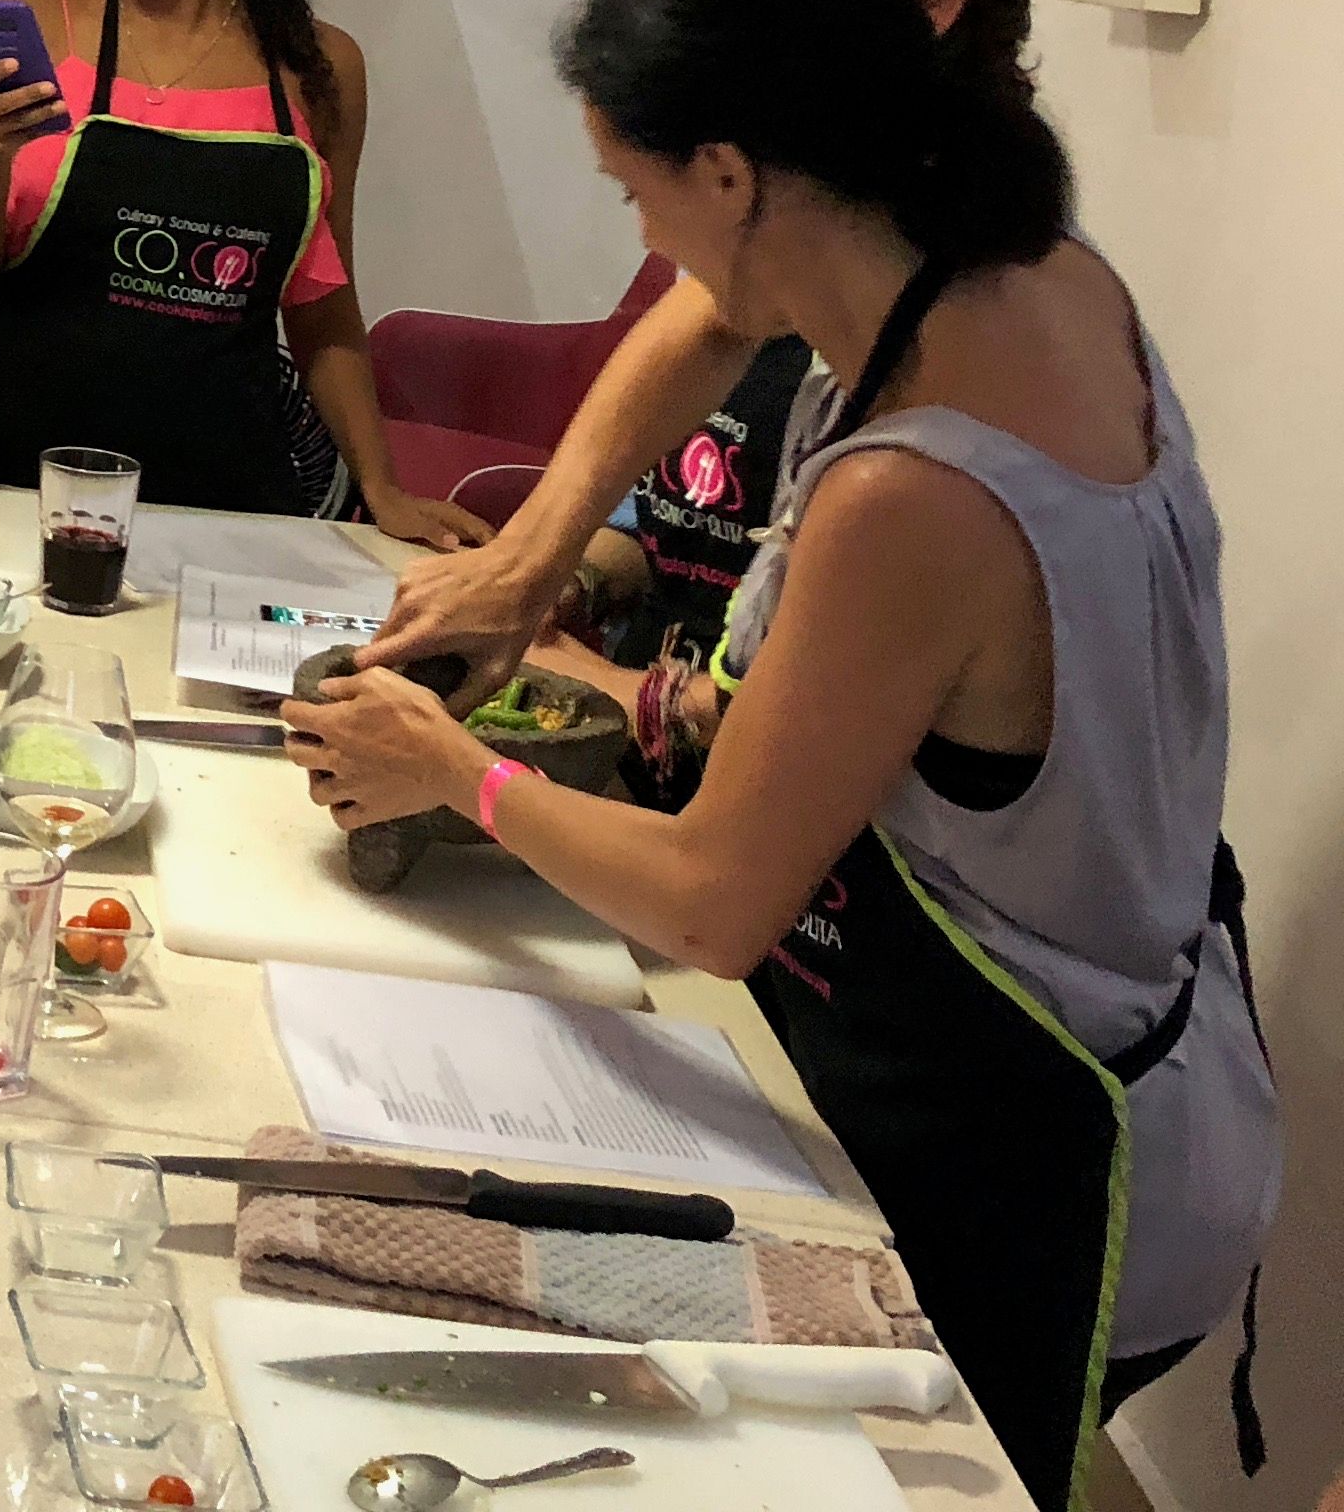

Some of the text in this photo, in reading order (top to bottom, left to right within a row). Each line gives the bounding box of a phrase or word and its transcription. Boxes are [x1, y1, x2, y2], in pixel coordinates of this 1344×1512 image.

[117, 207, 164, 226] Culinary
[169, 217, 210, 235] School
[213, 223, 223, 237] &
